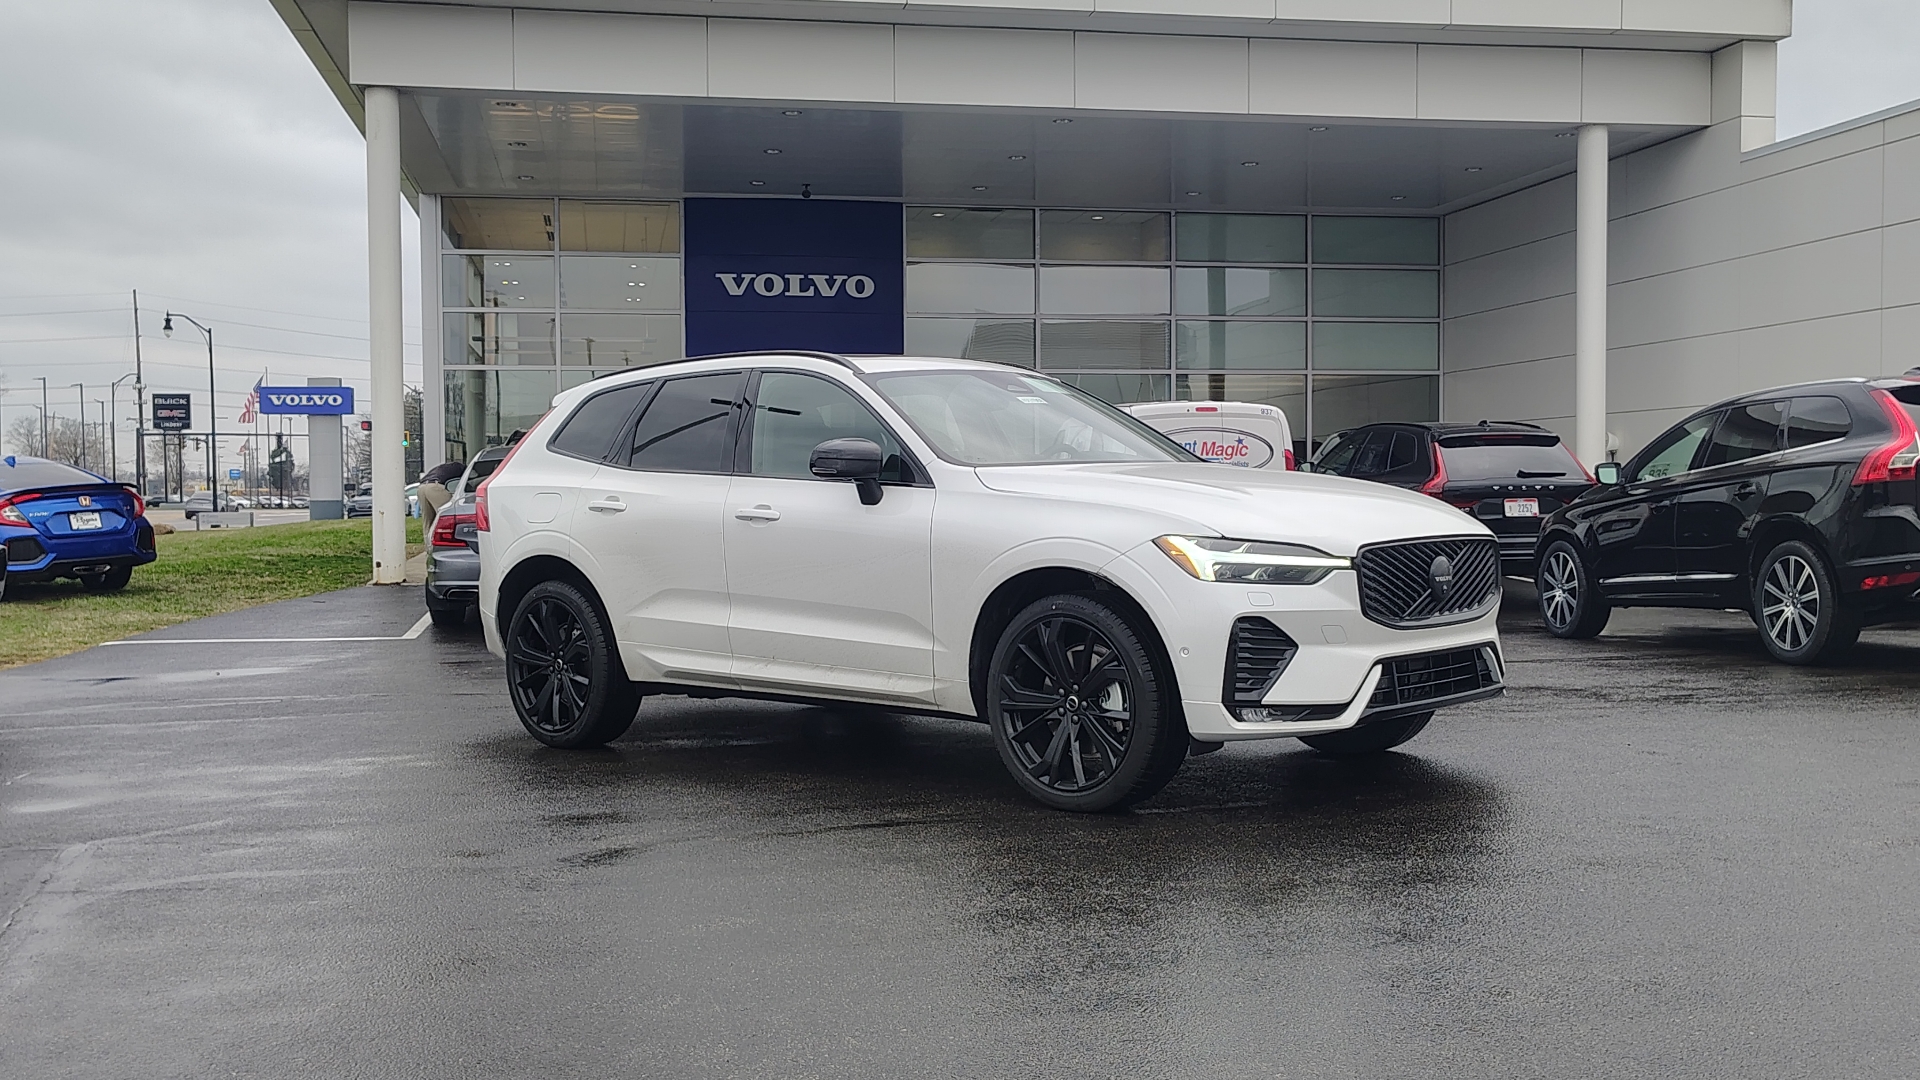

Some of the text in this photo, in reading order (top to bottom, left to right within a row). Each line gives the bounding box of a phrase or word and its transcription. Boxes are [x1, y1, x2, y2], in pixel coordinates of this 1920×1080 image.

[715, 273, 875, 298] VOLVO
[154, 397, 188, 405] BUICK
[267, 394, 343, 406] VOLVO
[157, 409, 186, 418] GMC
[1260, 408, 1273, 416] 937
[1200, 440, 1249, 461] Magic
[1517, 503, 1533, 514] 2252
